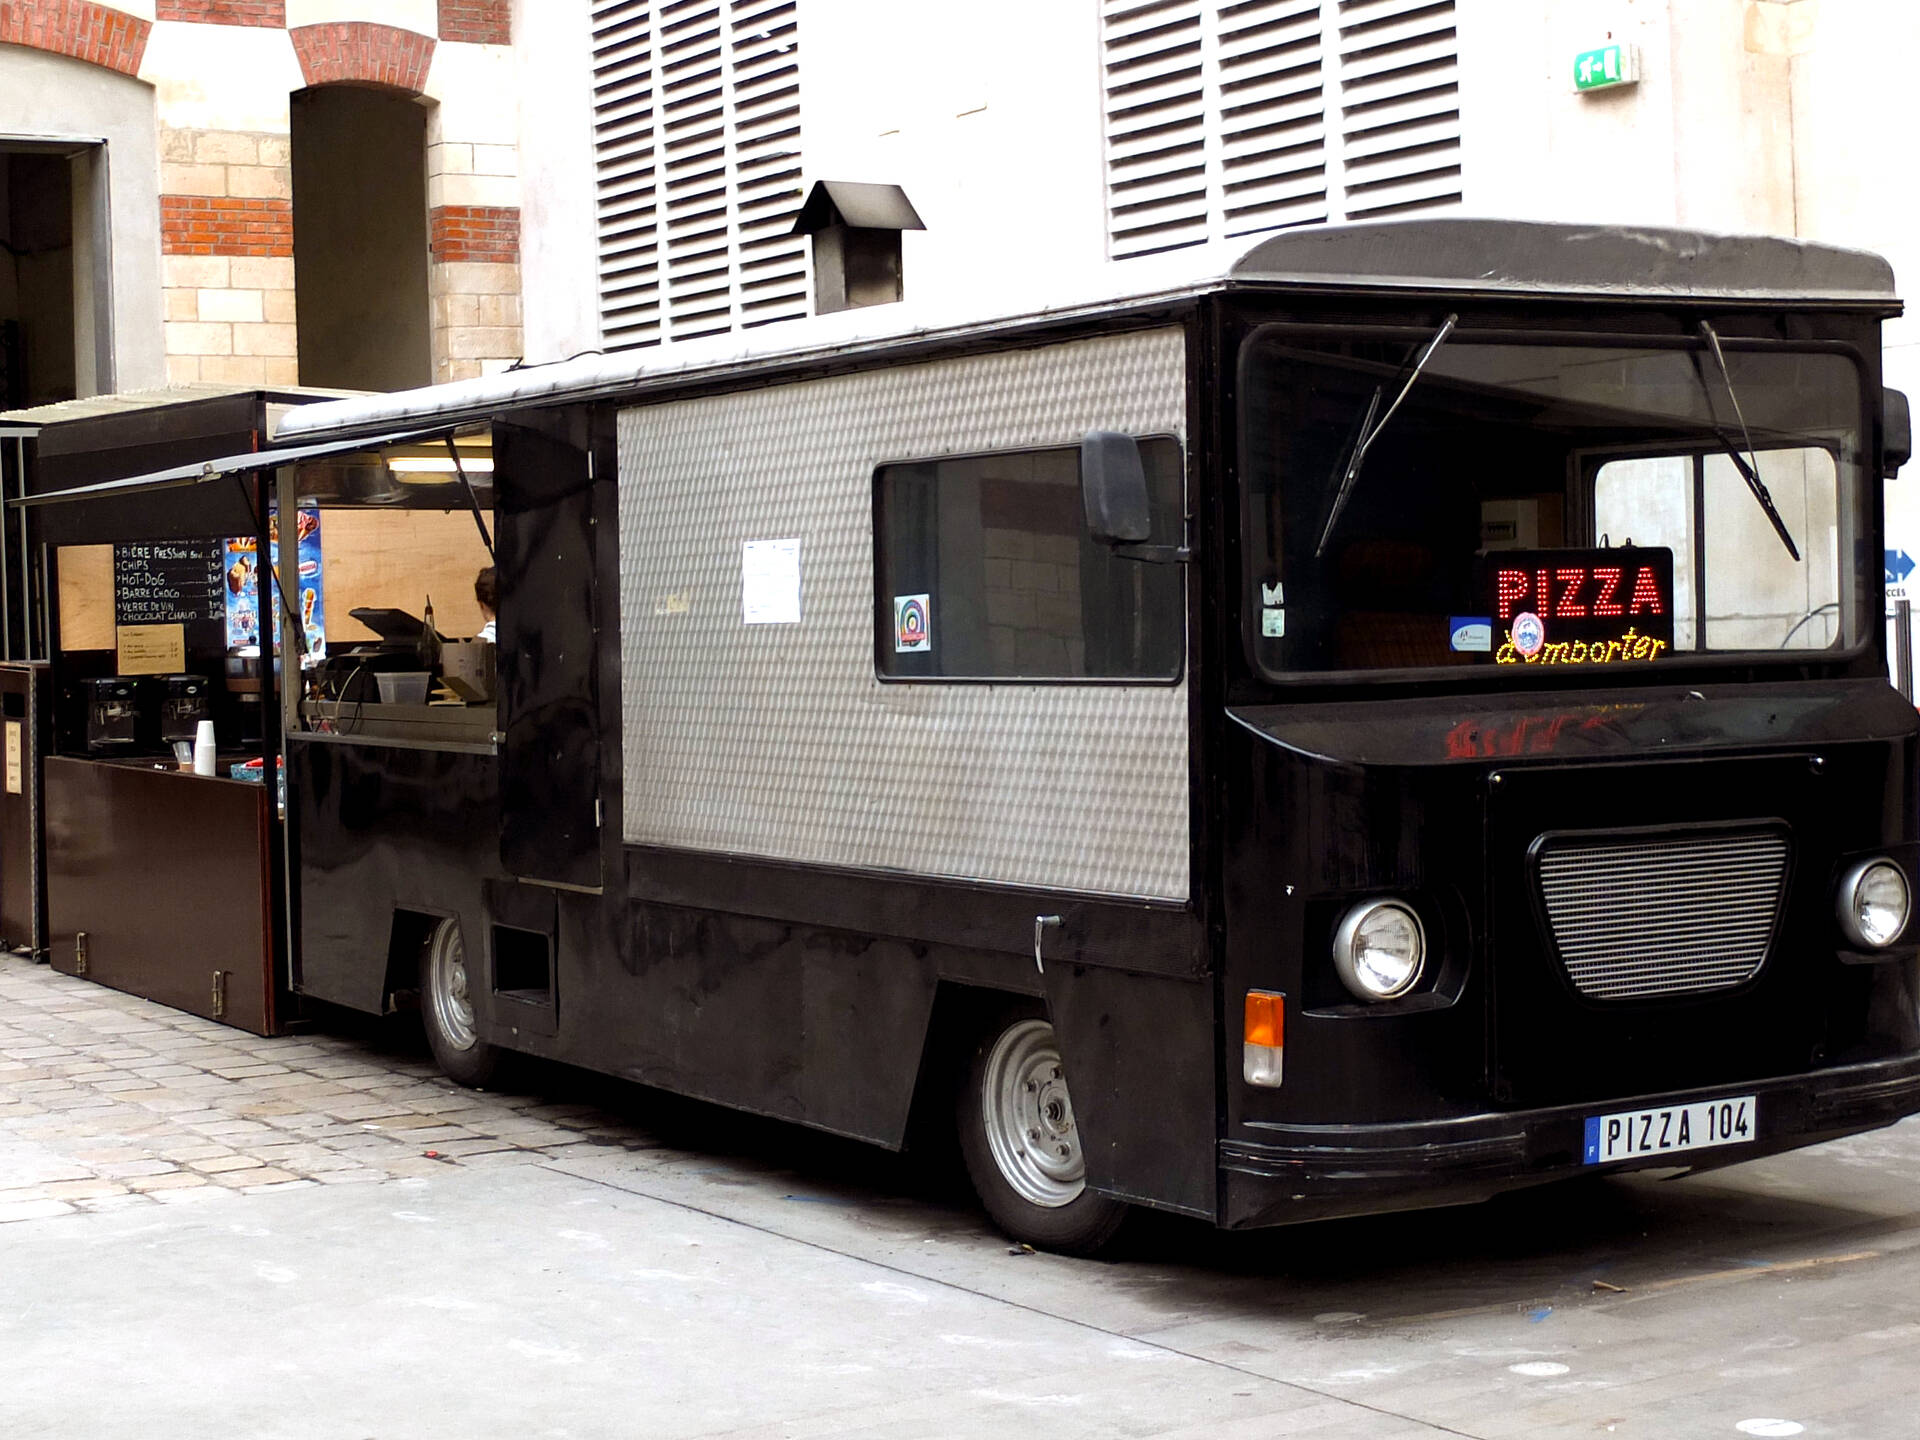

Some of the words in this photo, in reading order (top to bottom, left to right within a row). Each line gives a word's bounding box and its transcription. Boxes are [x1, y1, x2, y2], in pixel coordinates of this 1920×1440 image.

[121, 560, 149, 571] CHIPS
[122, 587, 151, 600] BARRE
[1498, 566, 1664, 618] PIZZA
[122, 601, 149, 612] VERRE
[122, 611, 168, 622] CHOCOLAT
[1607, 1109, 1691, 1156] PIZZA
[1707, 1101, 1748, 1141] 104
[1588, 1146, 1595, 1157] F
